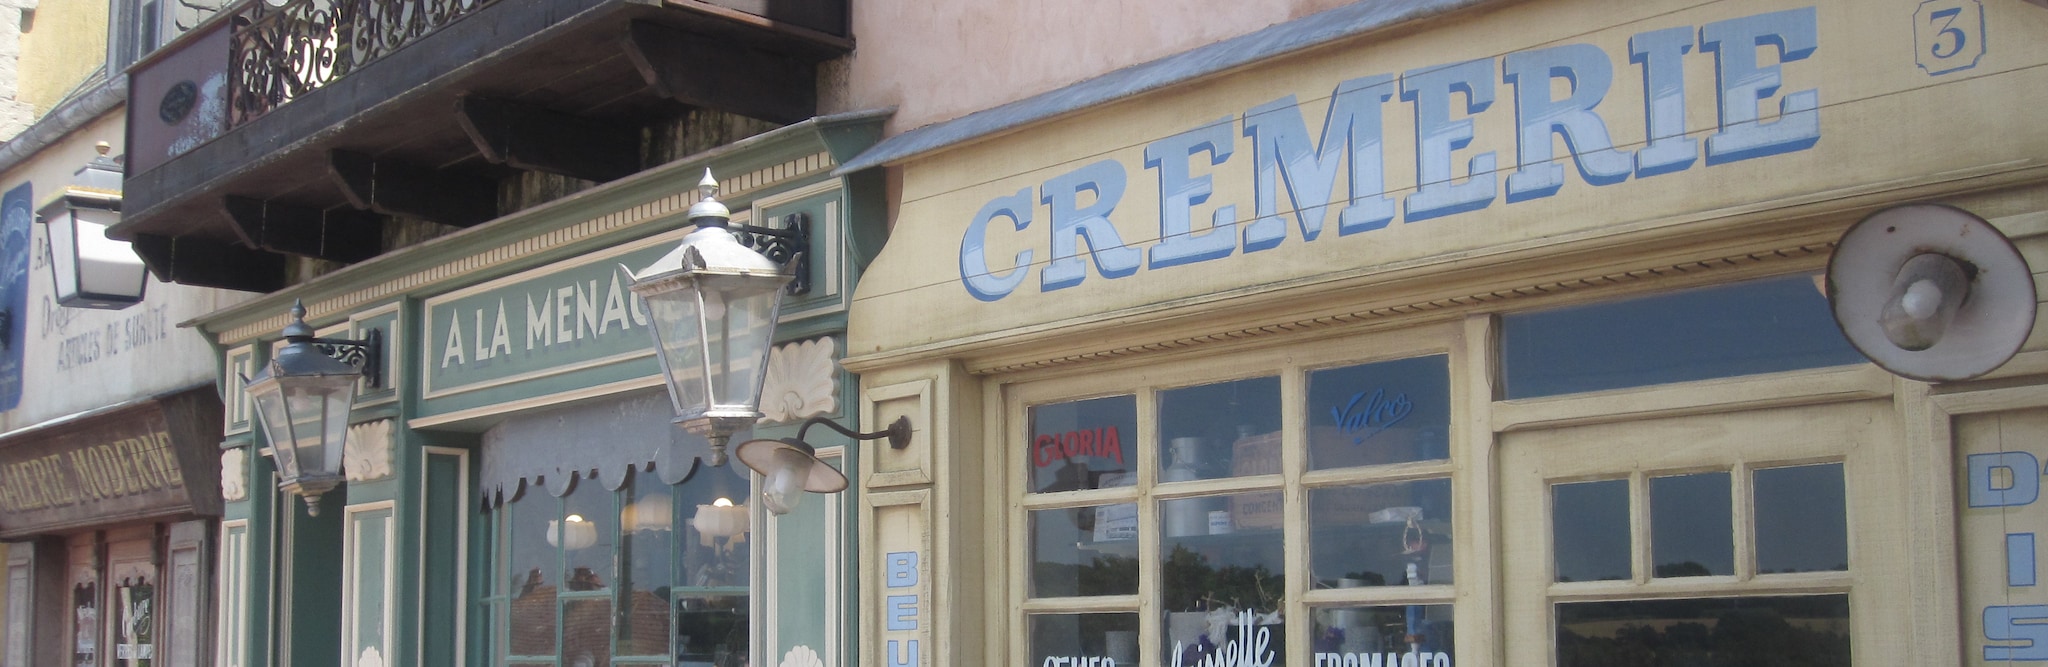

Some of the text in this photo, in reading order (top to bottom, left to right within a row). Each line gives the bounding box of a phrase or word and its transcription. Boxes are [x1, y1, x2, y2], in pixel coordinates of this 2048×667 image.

[1930, 7, 1966, 59] 3
[959, 7, 1822, 303] CREMERIE
[441, 308, 465, 369] A
[475, 297, 512, 362] LA
[69, 430, 184, 505] MODERNE
[1033, 424, 1125, 468] GLORIA
